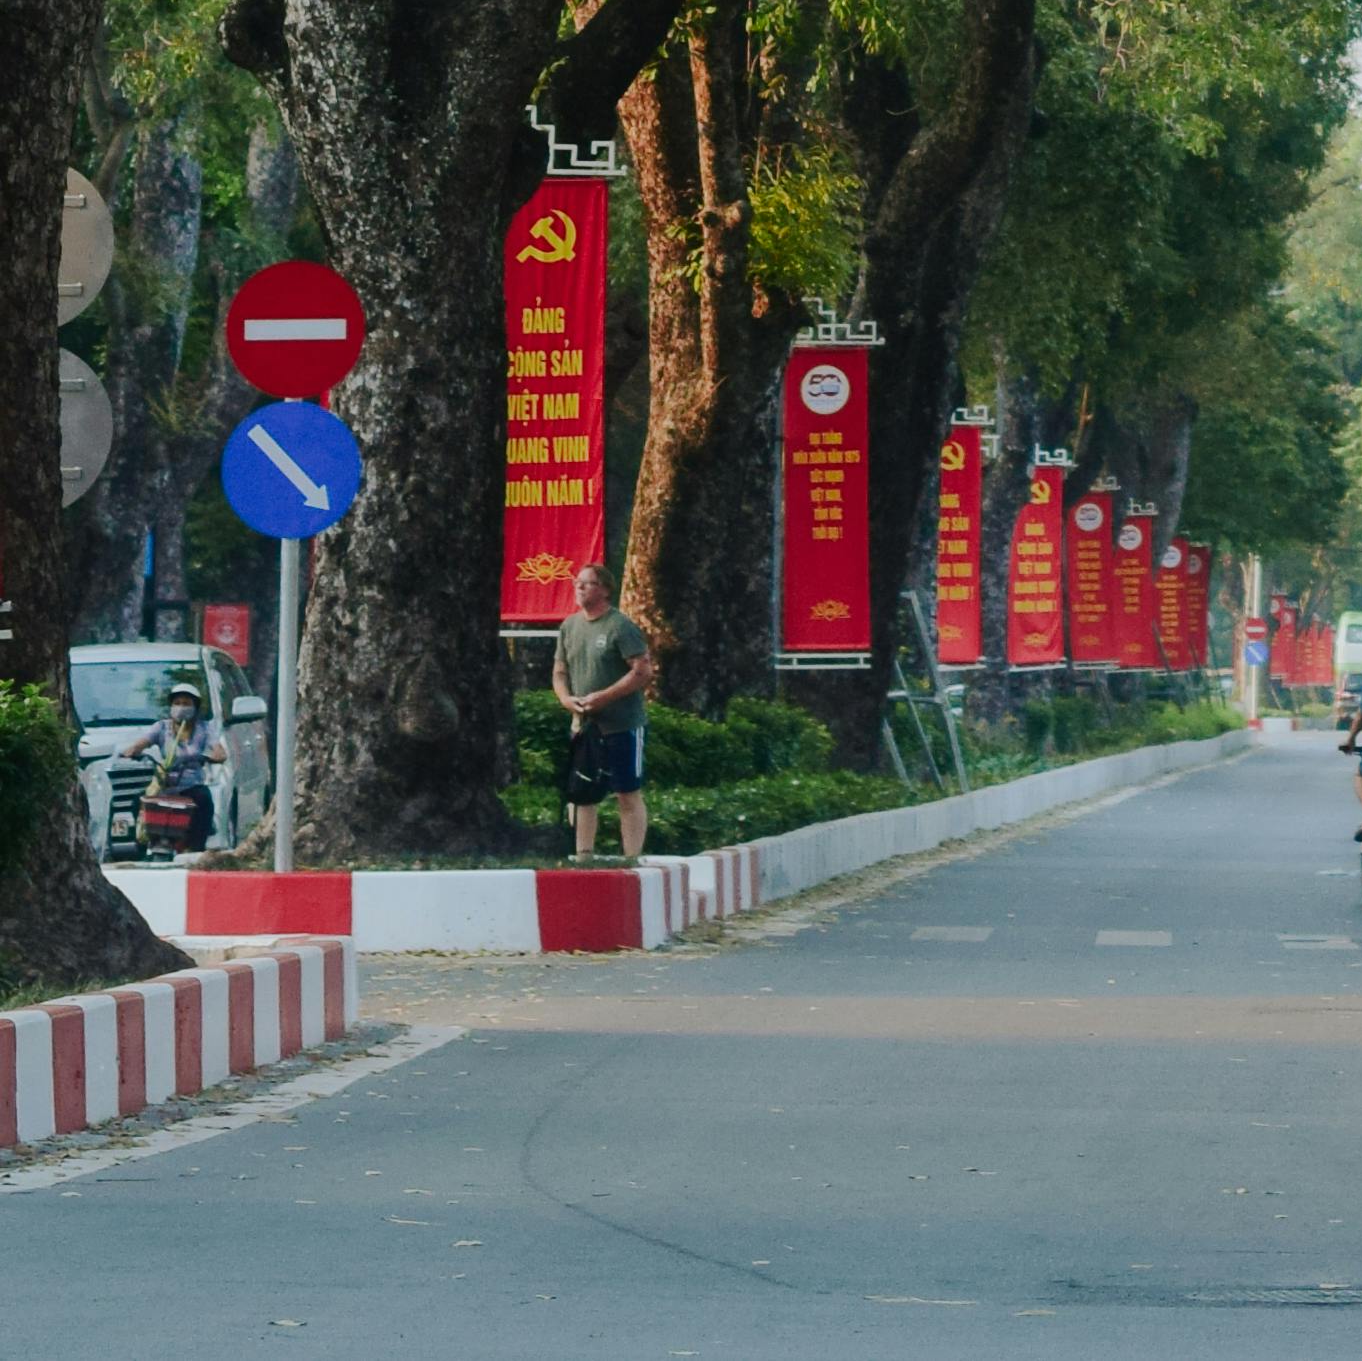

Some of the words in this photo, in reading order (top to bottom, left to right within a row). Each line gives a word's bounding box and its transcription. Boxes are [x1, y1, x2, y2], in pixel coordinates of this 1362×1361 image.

[522, 296, 565, 334] ĐẢNG
[551, 339, 583, 376] SẢN
[507, 388, 539, 426] VIỆT
[543, 393, 579, 420] NAM
[506, 437, 549, 464] UANG
[553, 436, 589, 463] VINH
[546, 474, 584, 507] NĂM
